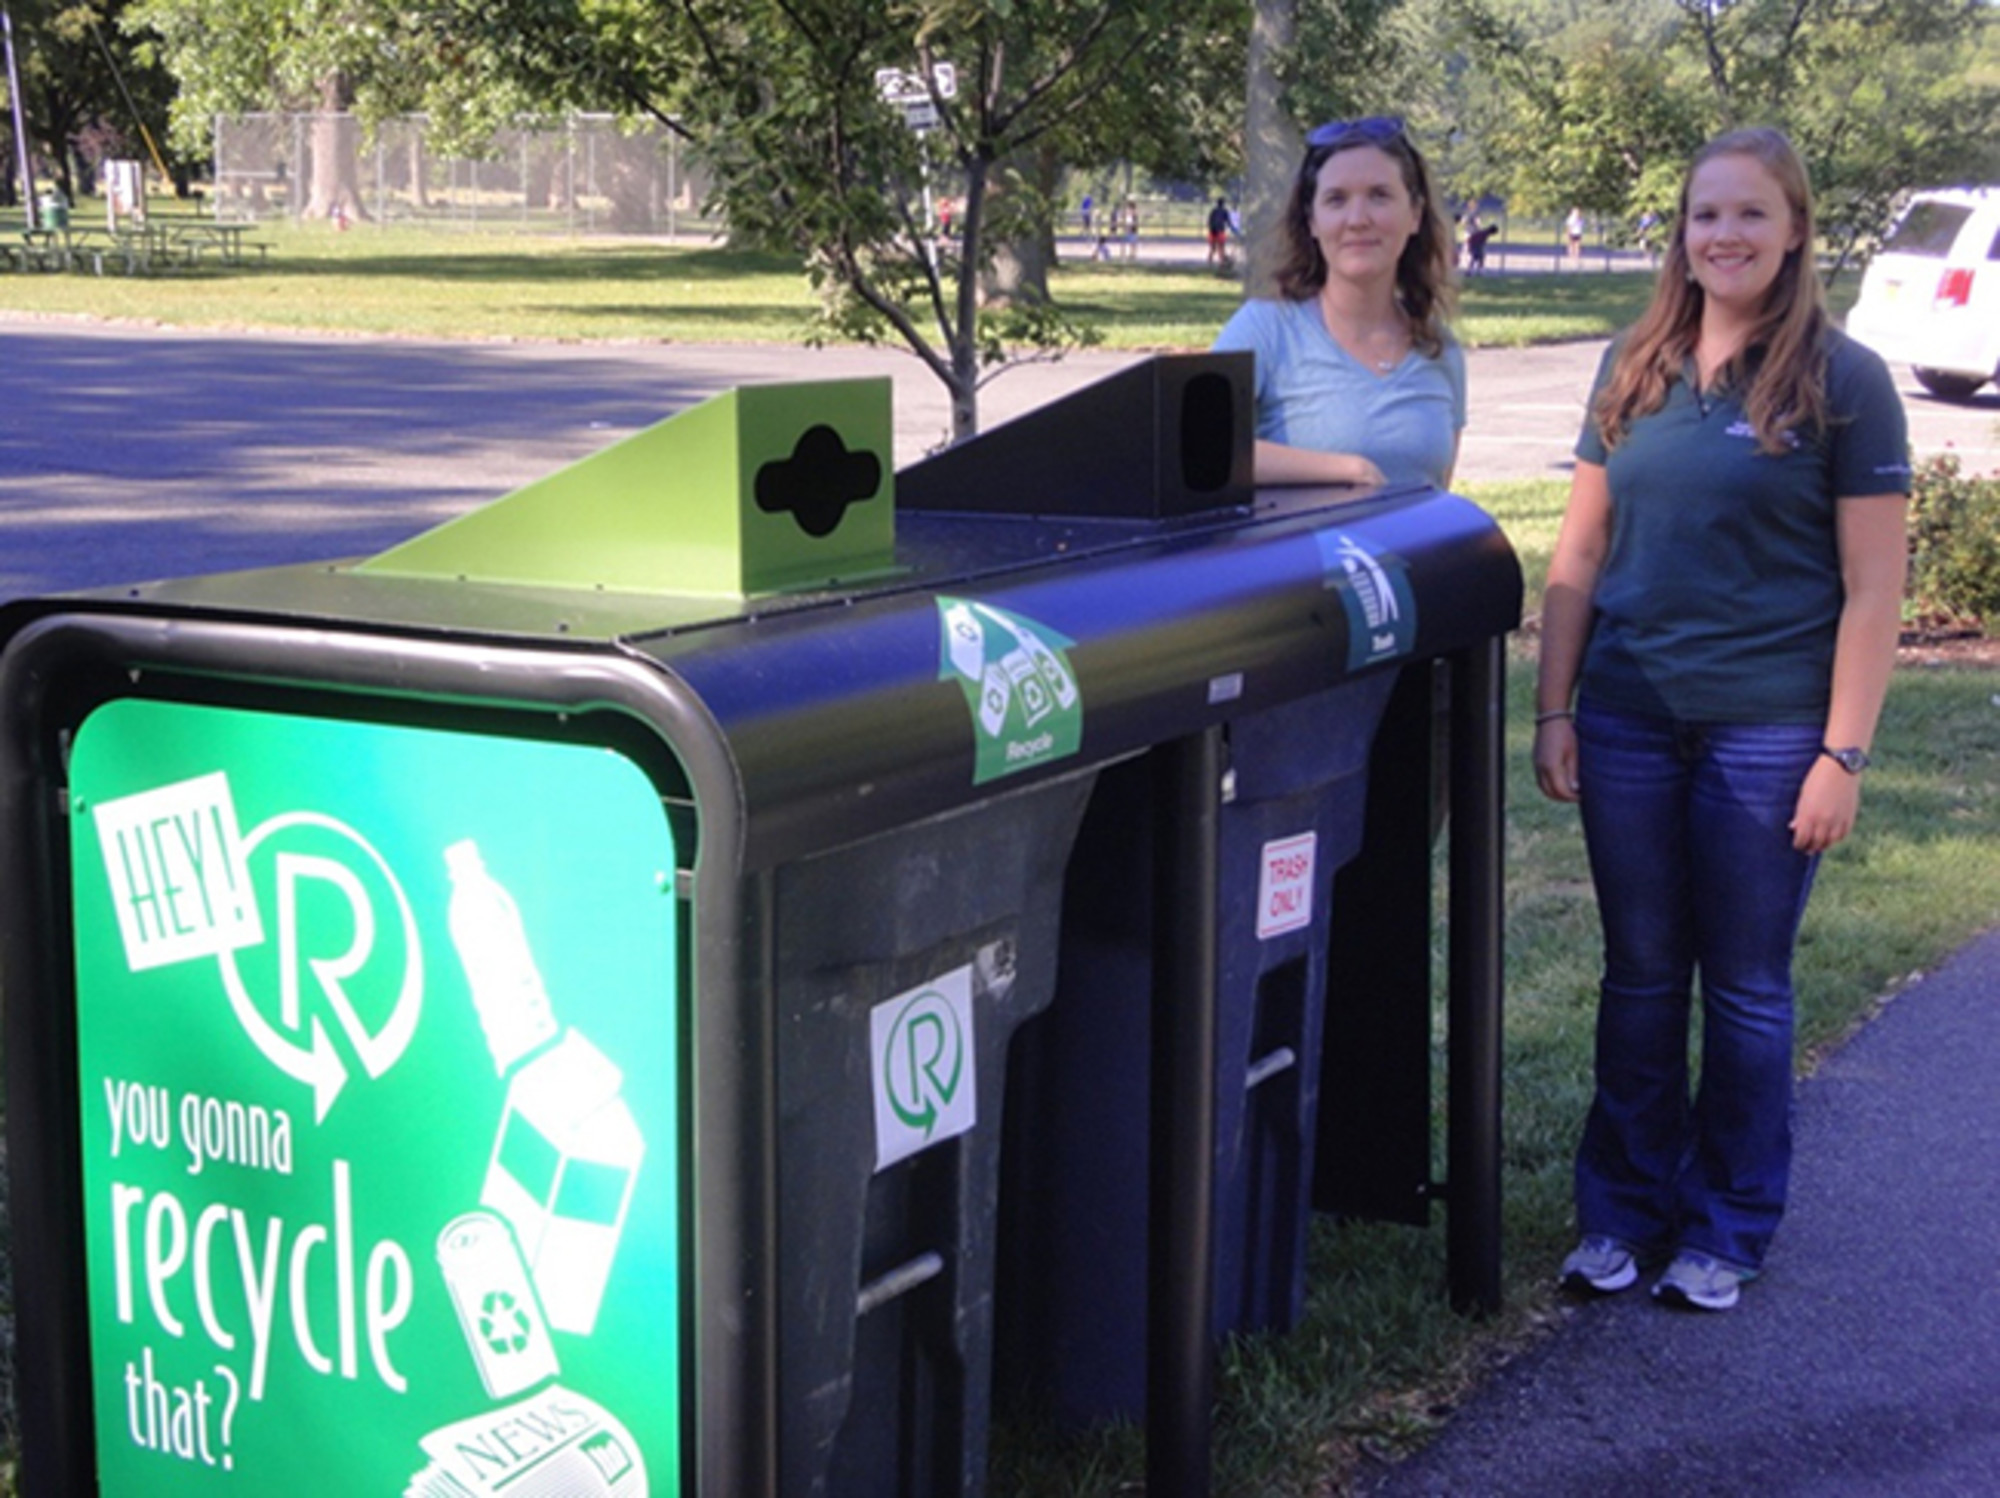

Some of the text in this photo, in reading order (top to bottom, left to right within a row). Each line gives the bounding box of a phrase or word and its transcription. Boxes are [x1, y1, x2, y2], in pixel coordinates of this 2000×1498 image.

[116, 804, 244, 943] HEY!
[1268, 853, 1310, 885] TRASH
[1269, 885, 1305, 918] ONLY
[104, 1076, 292, 1175] you gonna
[110, 1158, 414, 1401] recycle
[124, 1346, 240, 1471] that?
[455, 1402, 593, 1481] NEWS
